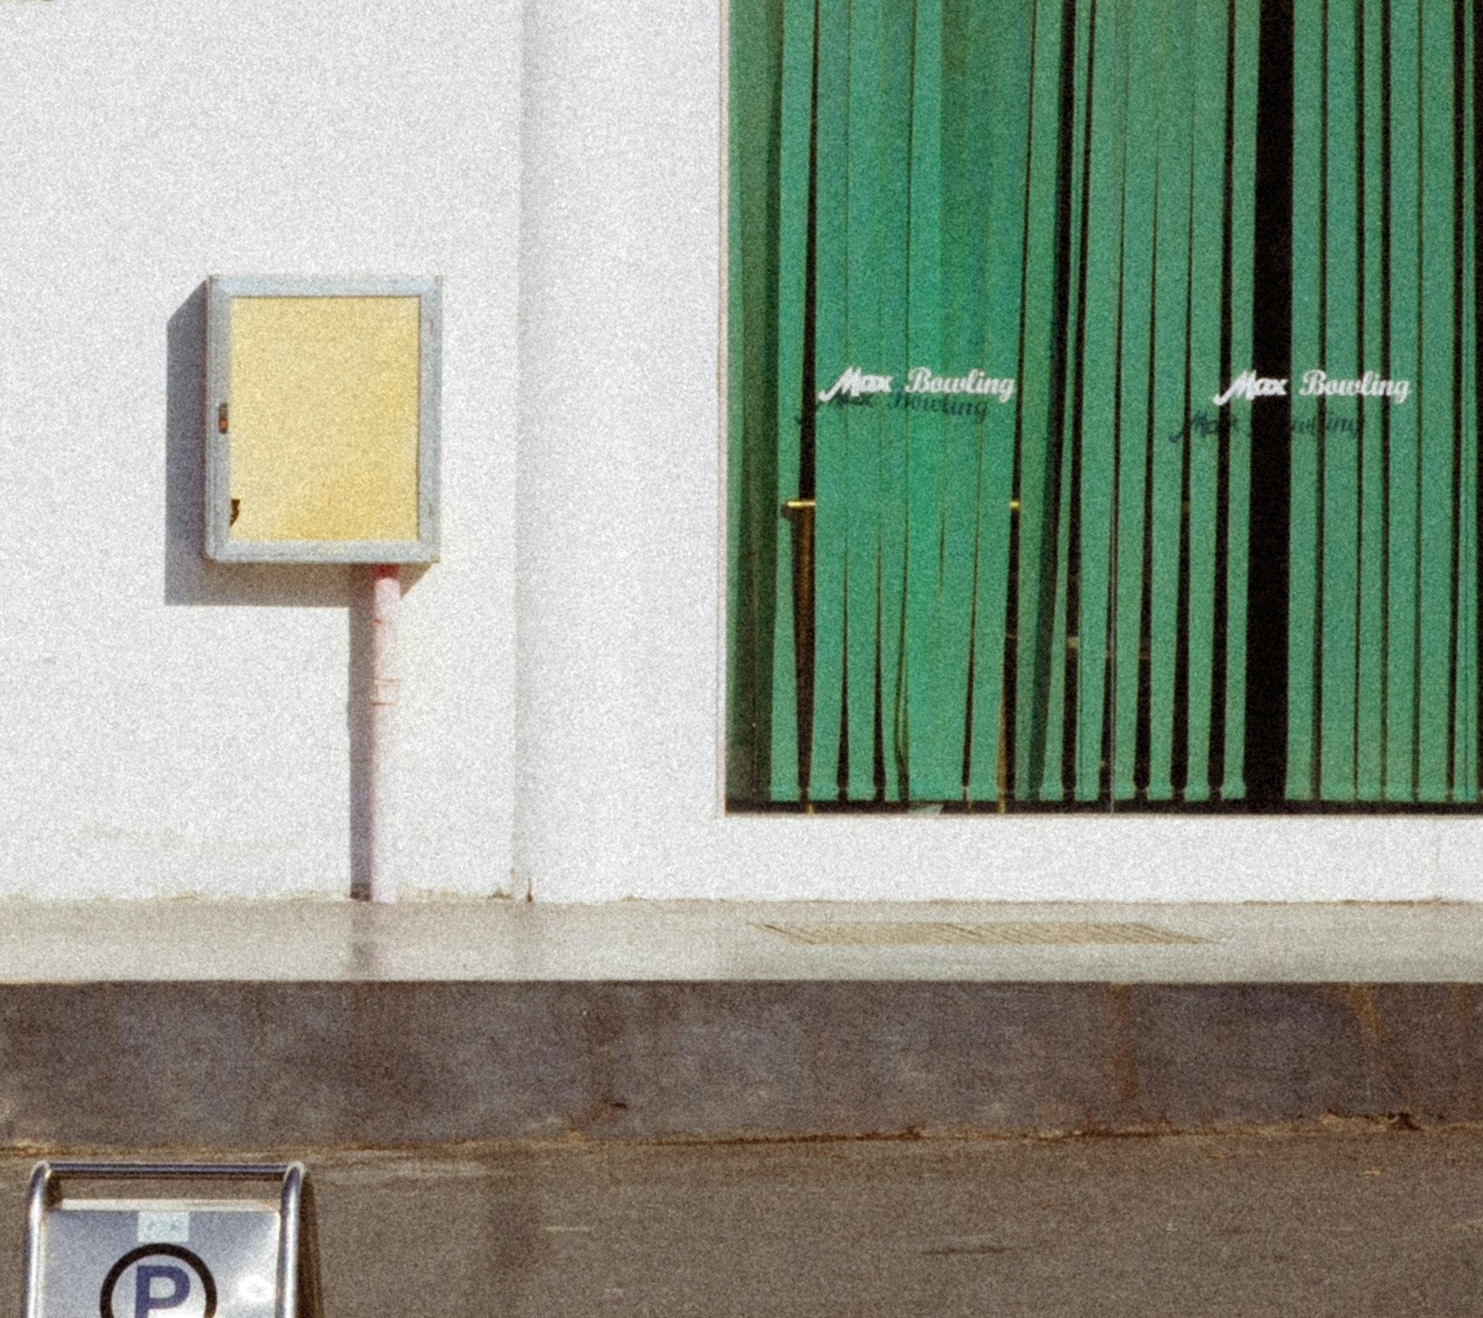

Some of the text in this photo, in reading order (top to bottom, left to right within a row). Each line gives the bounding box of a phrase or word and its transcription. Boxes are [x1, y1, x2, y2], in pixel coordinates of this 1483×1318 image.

[818, 366, 1017, 403] Max Bowling
[1212, 369, 1411, 406] Max Bowling
